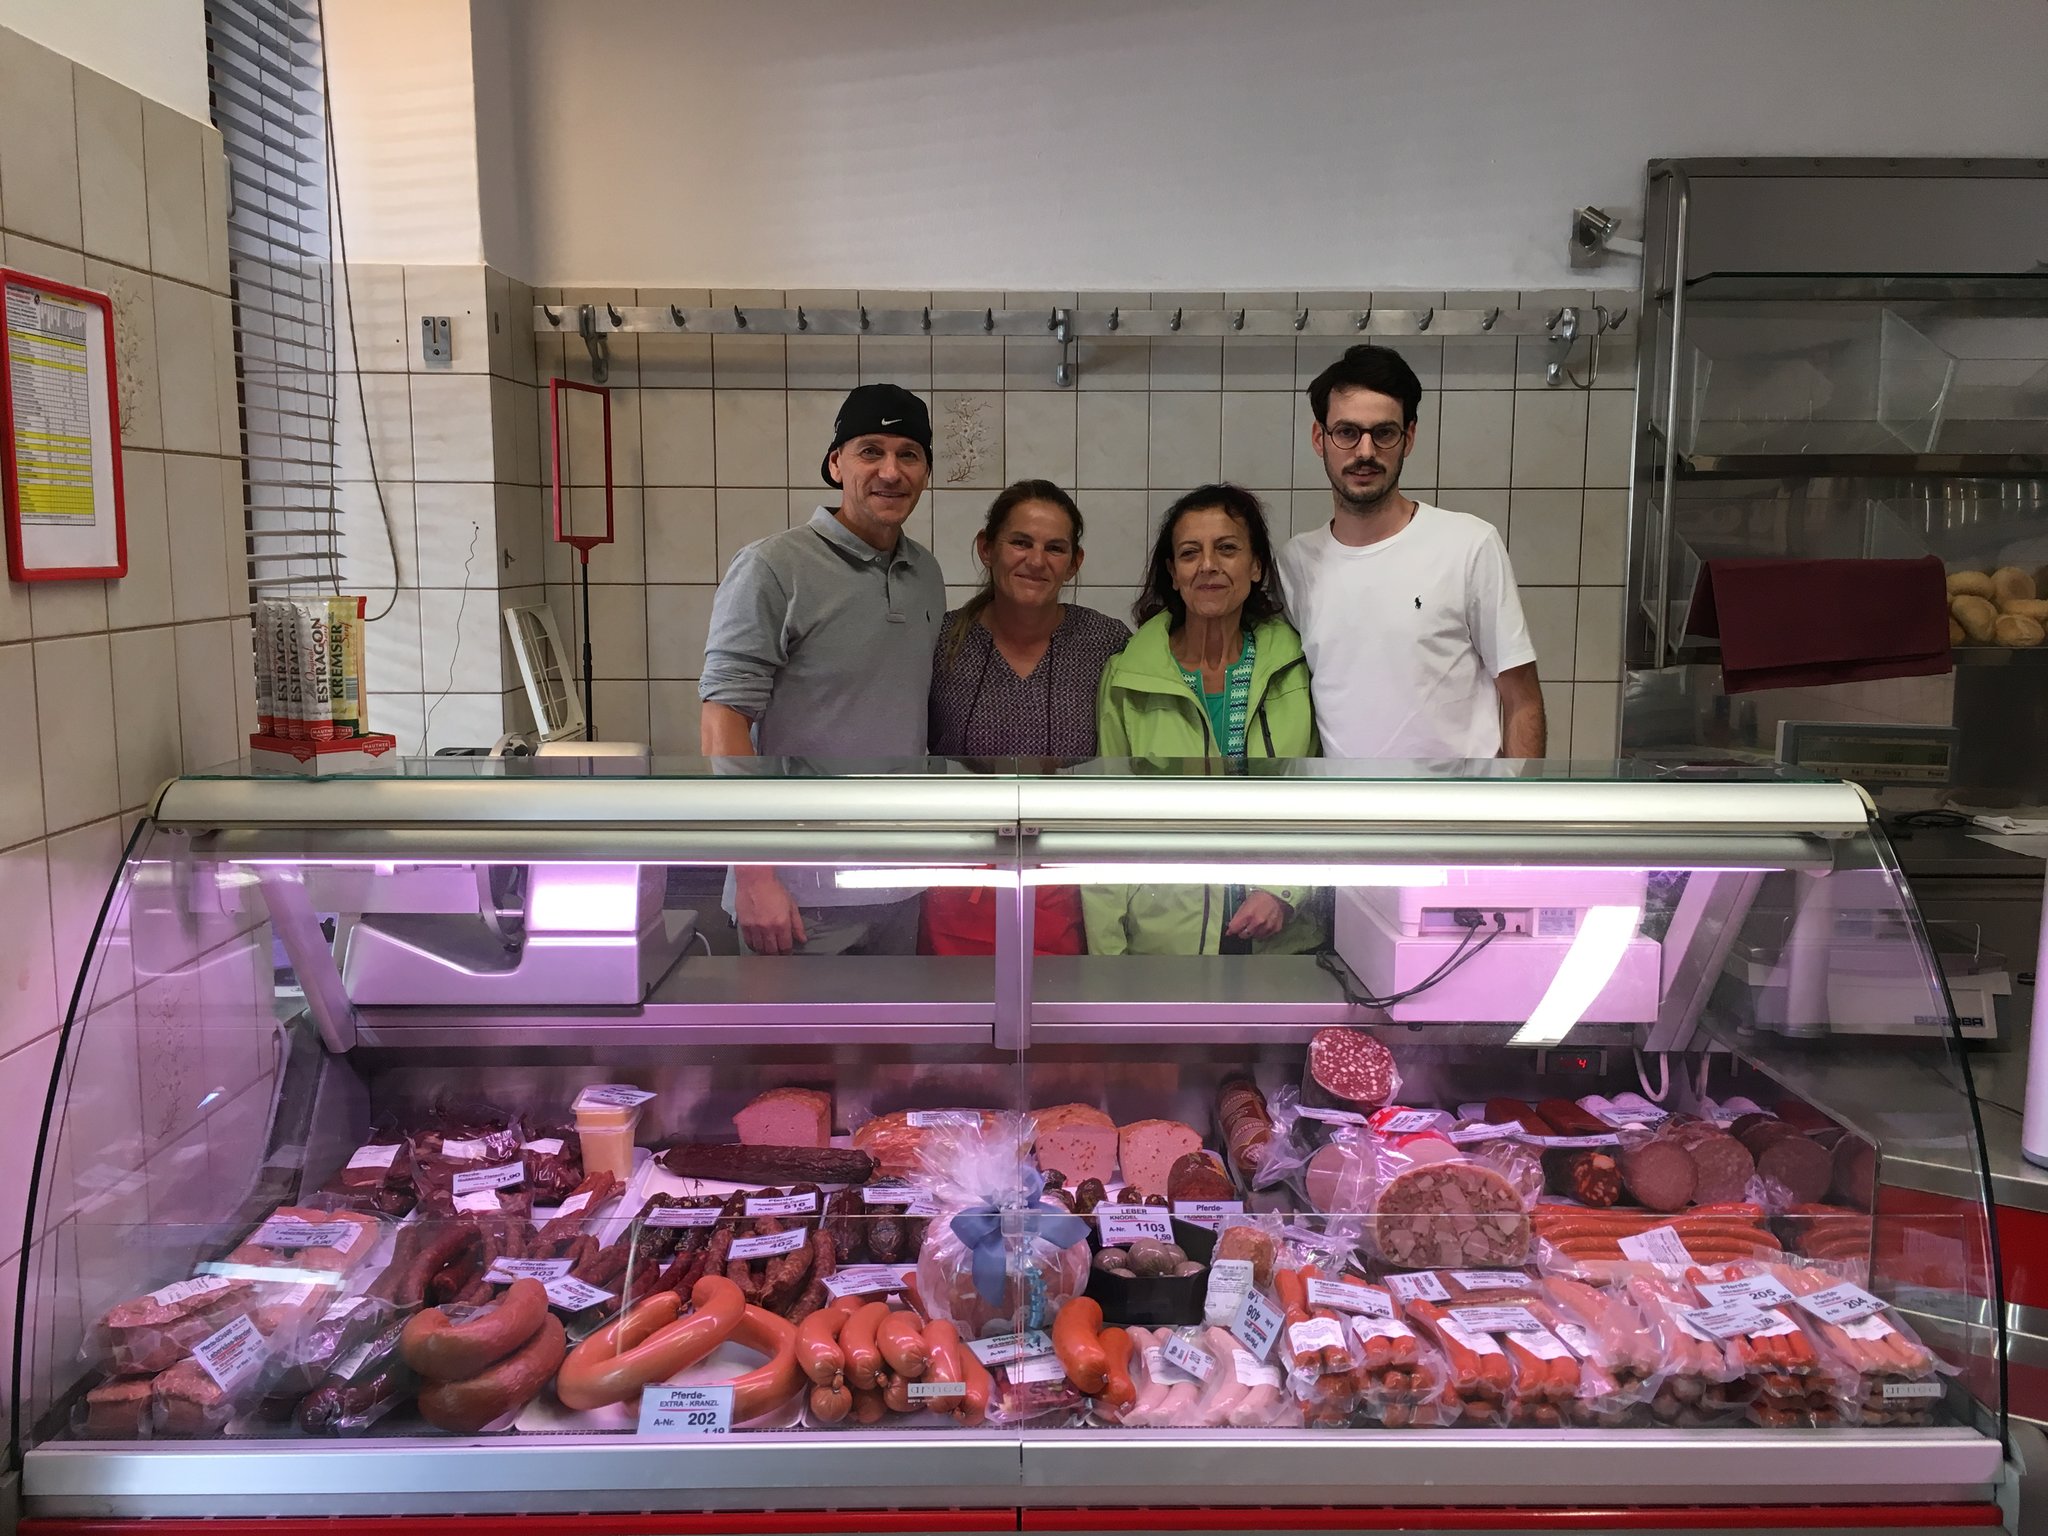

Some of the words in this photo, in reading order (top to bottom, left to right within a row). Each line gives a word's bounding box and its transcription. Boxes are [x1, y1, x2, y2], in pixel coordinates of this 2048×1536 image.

[338, 620, 352, 648] Senf
[310, 618, 328, 704] ESTRAGON
[331, 624, 344, 698] KREMSER
[1136, 1223, 1165, 1232] 1103
[769, 1240, 793, 1248] 402
[568, 1295, 588, 1303] 410
[1248, 1290, 1258, 1303] 1,49
[1749, 1289, 1776, 1300] 205
[1843, 1297, 1868, 1309] 204
[1246, 1305, 1260, 1322] 406
[1368, 1306, 1390, 1316] 1,49
[688, 1412, 716, 1425] 202
